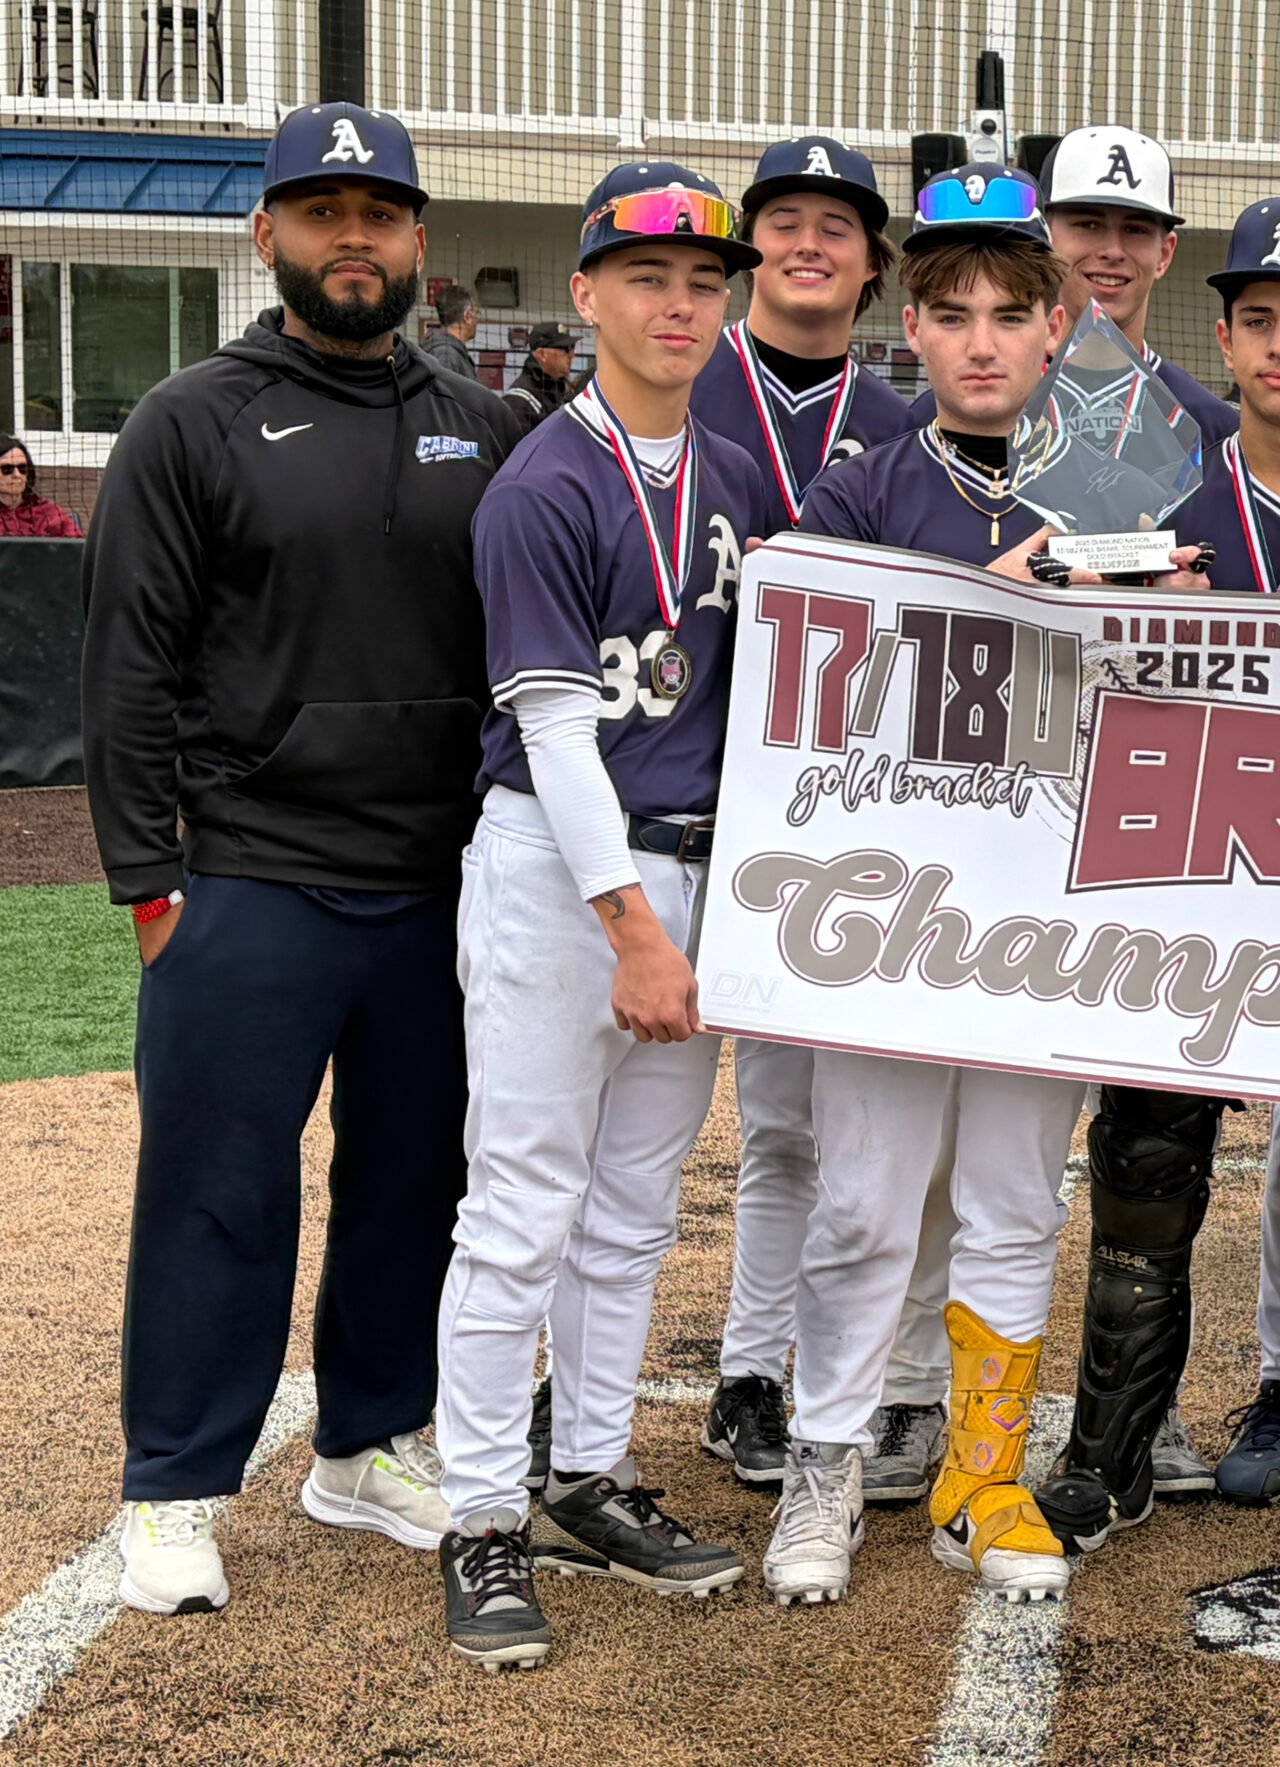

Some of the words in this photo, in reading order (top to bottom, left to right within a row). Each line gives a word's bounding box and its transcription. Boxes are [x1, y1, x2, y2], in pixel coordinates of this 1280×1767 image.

[322, 118, 374, 164] A
[801, 146, 841, 178] A
[1096, 144, 1142, 190] A
[1066, 416, 1140, 432] NATION
[696, 514, 740, 614] A
[756, 581, 1083, 780] 17/18U
[1136, 651, 1271, 695] 2025
[787, 748, 891, 828] gold
[889, 761, 1037, 818] bracket
